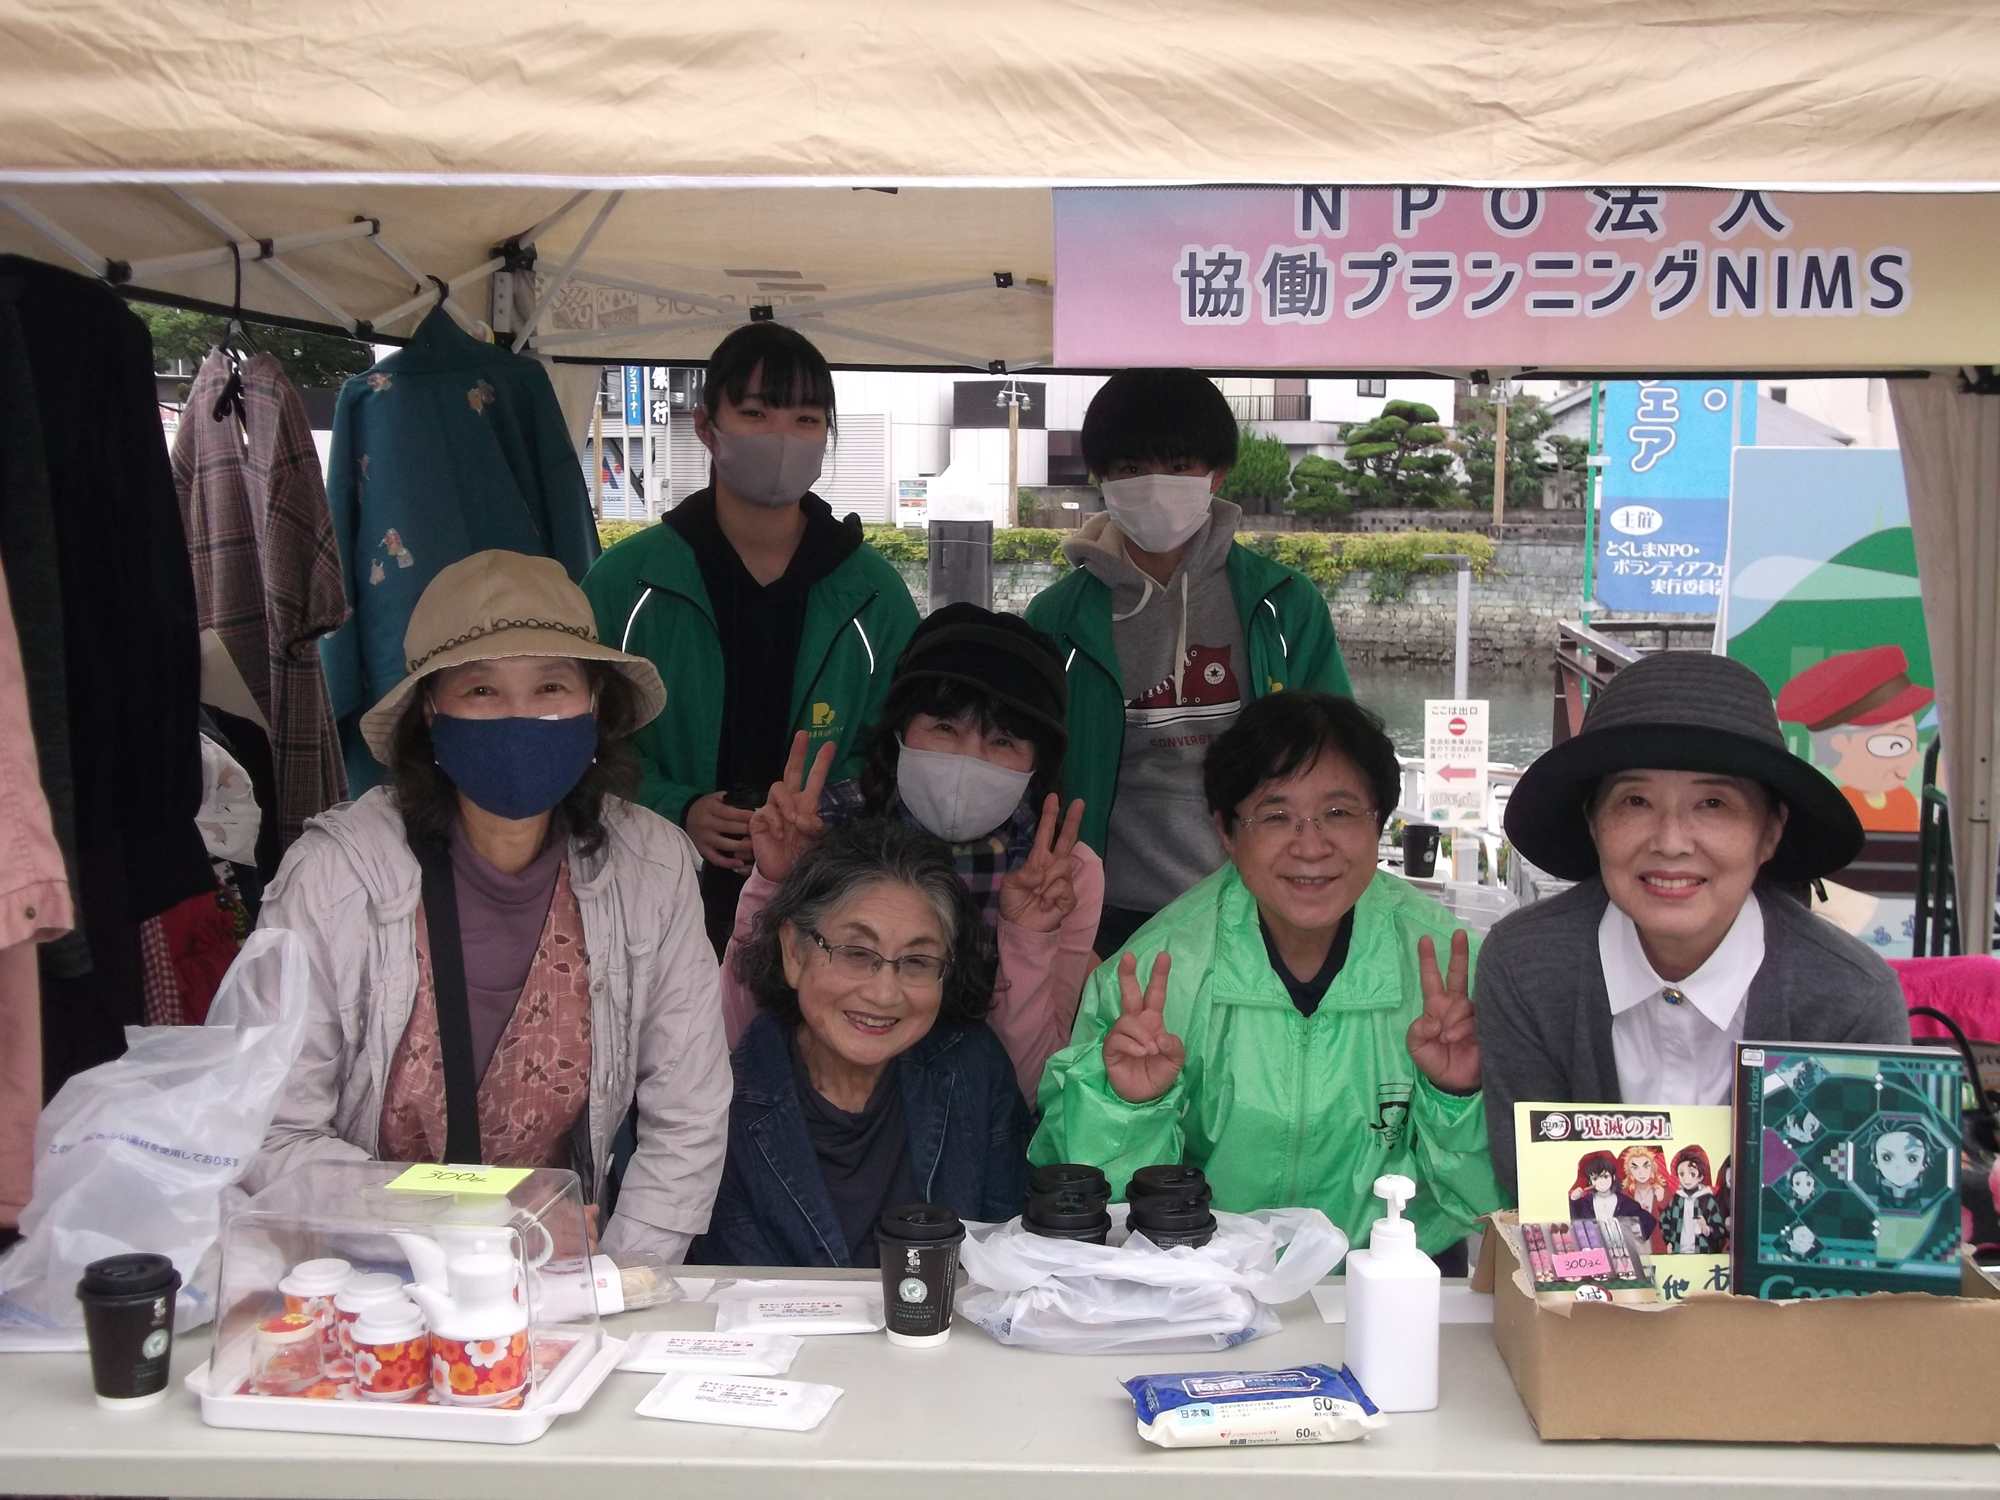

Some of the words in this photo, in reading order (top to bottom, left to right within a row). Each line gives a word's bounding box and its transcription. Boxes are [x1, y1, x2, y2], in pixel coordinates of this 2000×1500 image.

[1180, 248, 1904, 318] 協働プランニングNIMS
[1619, 510, 1655, 528] 主催
[1432, 706, 1478, 716] ここは出口
[1181, 1408, 1210, 1419] 日本製
[1296, 1427, 1323, 1439] 60枚入
